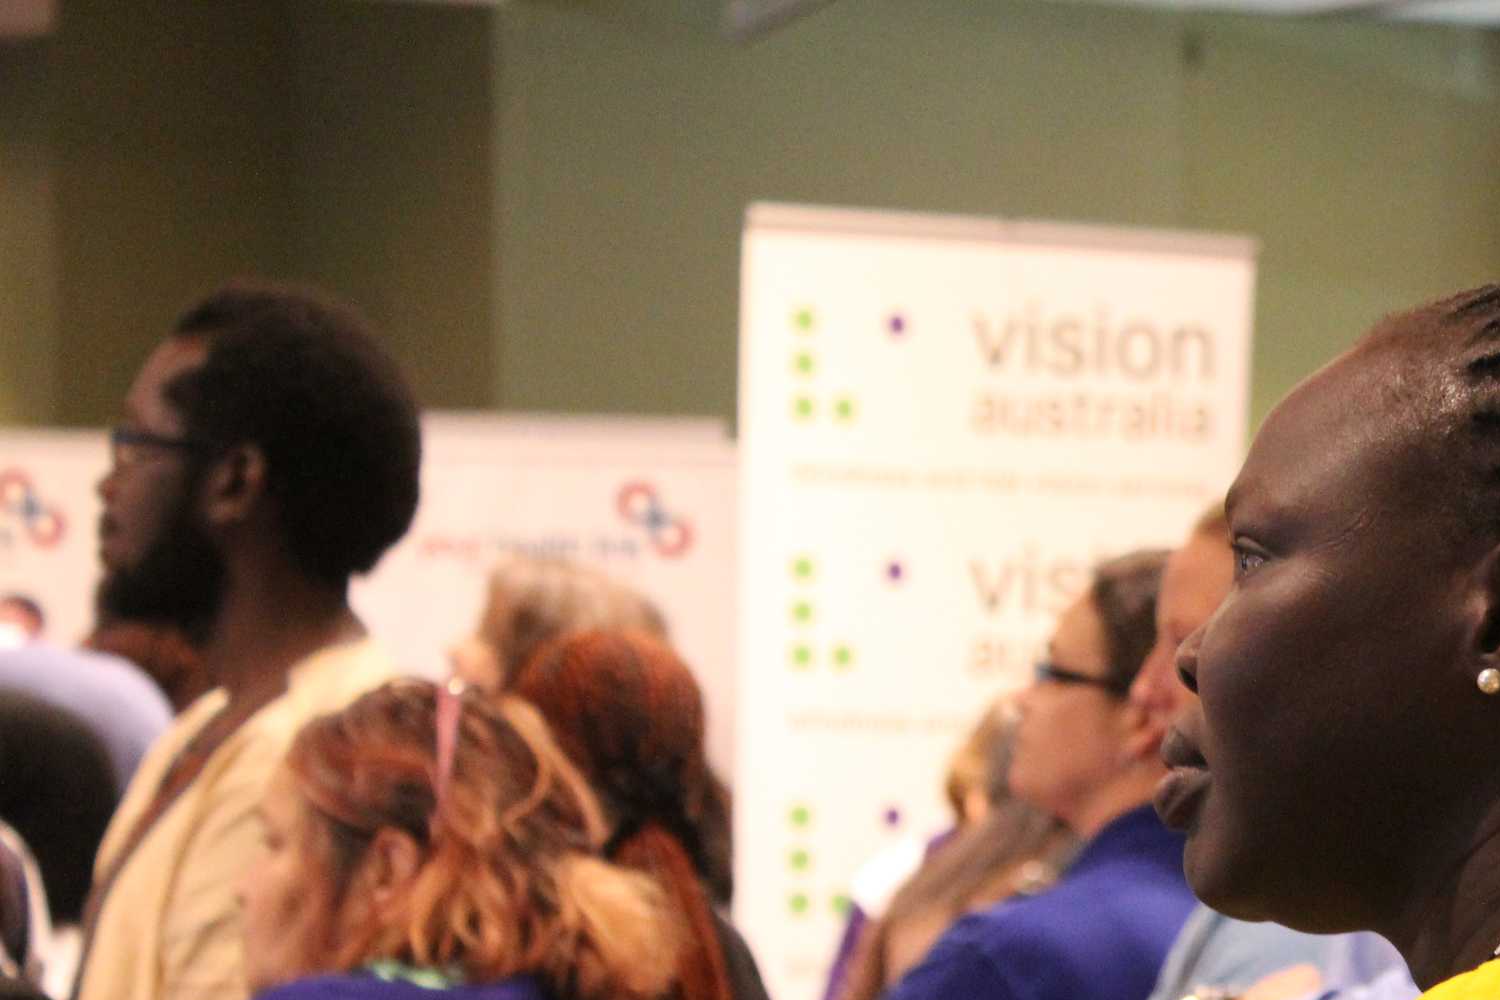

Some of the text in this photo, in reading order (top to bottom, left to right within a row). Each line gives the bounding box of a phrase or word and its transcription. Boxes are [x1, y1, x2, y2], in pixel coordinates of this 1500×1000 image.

[971, 303, 1215, 380] vision
[972, 391, 1214, 442] australia
[967, 541, 1088, 617] vis
